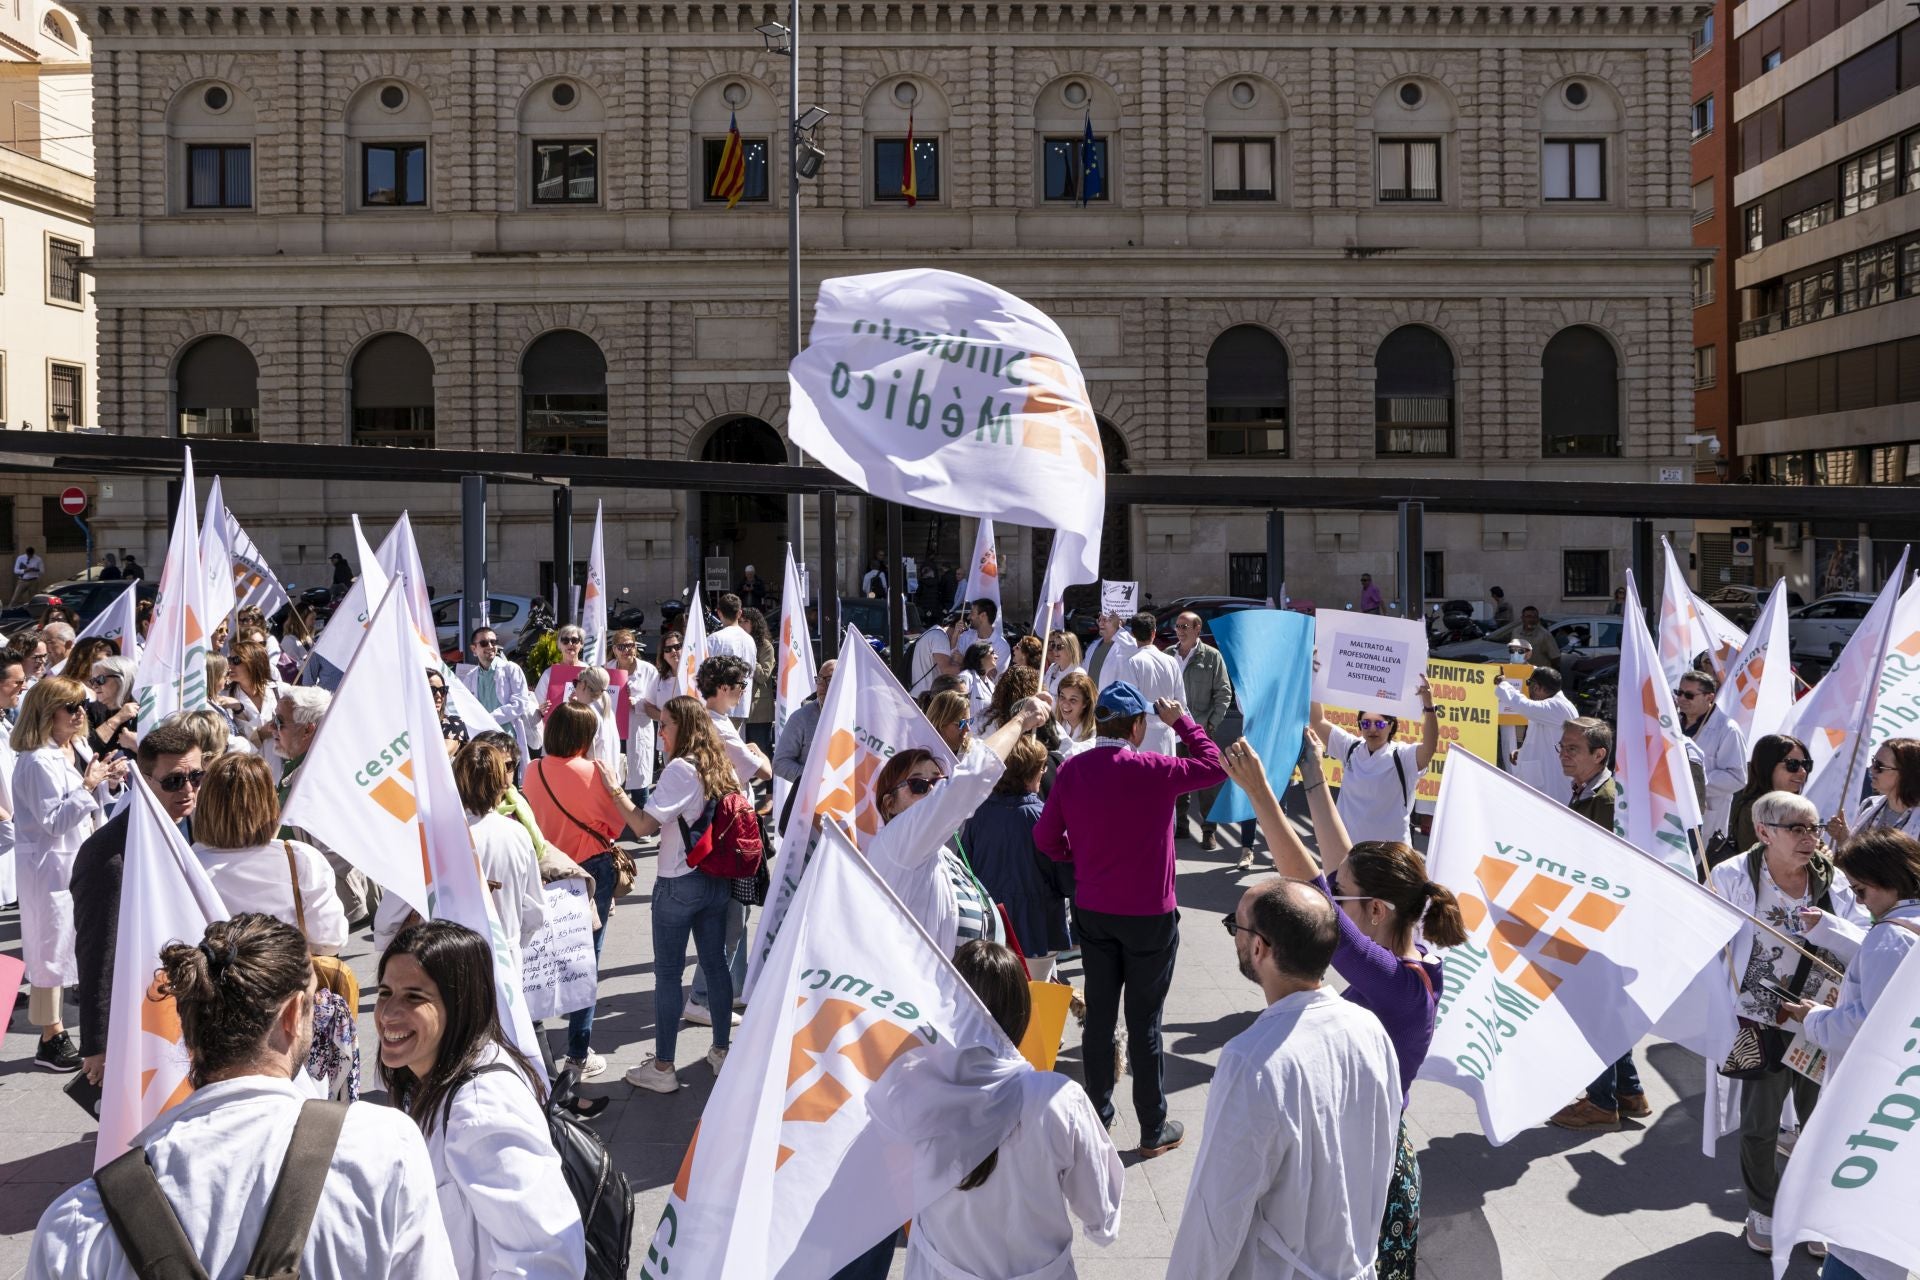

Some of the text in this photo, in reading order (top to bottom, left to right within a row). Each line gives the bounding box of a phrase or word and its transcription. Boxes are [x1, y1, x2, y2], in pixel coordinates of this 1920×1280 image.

[1824, 574, 1854, 592] maje
[1350, 640, 1384, 652] MALTRATO
[1339, 649, 1401, 664] PROFESIONAL LLEVA
[1735, 641, 1769, 677] cesmc
[1348, 672, 1386, 683] ASISTENCIAL
[1355, 663, 1390, 674] DETERIORO
[1426, 664, 1485, 684] NFINITAS
[355, 730, 410, 786] cesm
[1823, 986, 1839, 1007] 022
